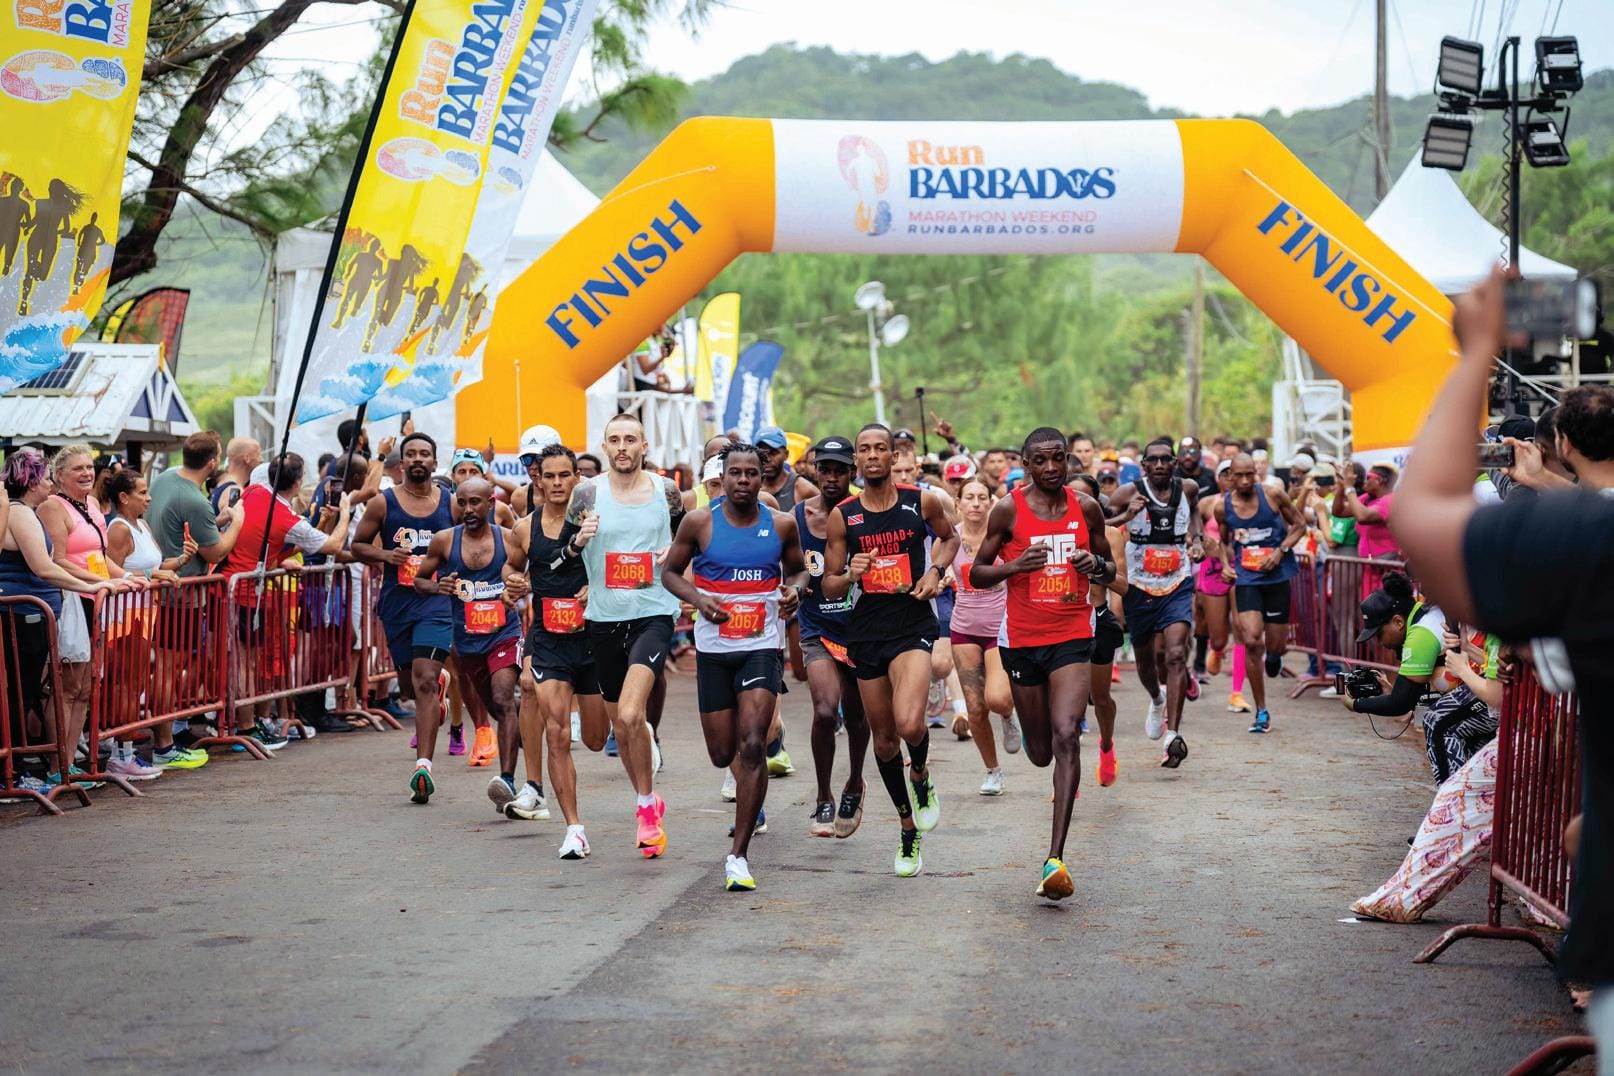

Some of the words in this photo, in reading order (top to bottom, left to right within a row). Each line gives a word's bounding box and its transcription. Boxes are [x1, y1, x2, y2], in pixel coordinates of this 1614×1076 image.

[437, 0, 516, 138] BARBA
[475, 74, 503, 142] MARATHON
[495, 13, 523, 72] WEEKEND
[492, 0, 571, 155] BARBAD
[401, 40, 456, 126] Run
[521, 96, 549, 159] MARATHON
[542, 38, 571, 96] WEEKEND
[907, 139, 985, 166] Run
[909, 166, 1116, 199] BARBADOS
[908, 210, 1006, 223] MARATHON
[1011, 210, 1097, 222] WEEKEND
[907, 224, 1096, 234] RUNBARBADOS.ORG
[545, 199, 702, 349] FINISH
[1256, 201, 1417, 344] FINISH
[859, 529, 906, 548] TRINIDAD
[862, 542, 899, 556] TOAGO
[613, 564, 645, 579] 2068
[731, 568, 762, 581] JOSH
[871, 567, 902, 585] 2138
[1038, 576, 1071, 593] 2054
[471, 610, 499, 625] 2044
[551, 609, 577, 625] 2132
[727, 614, 759, 629] 2067
